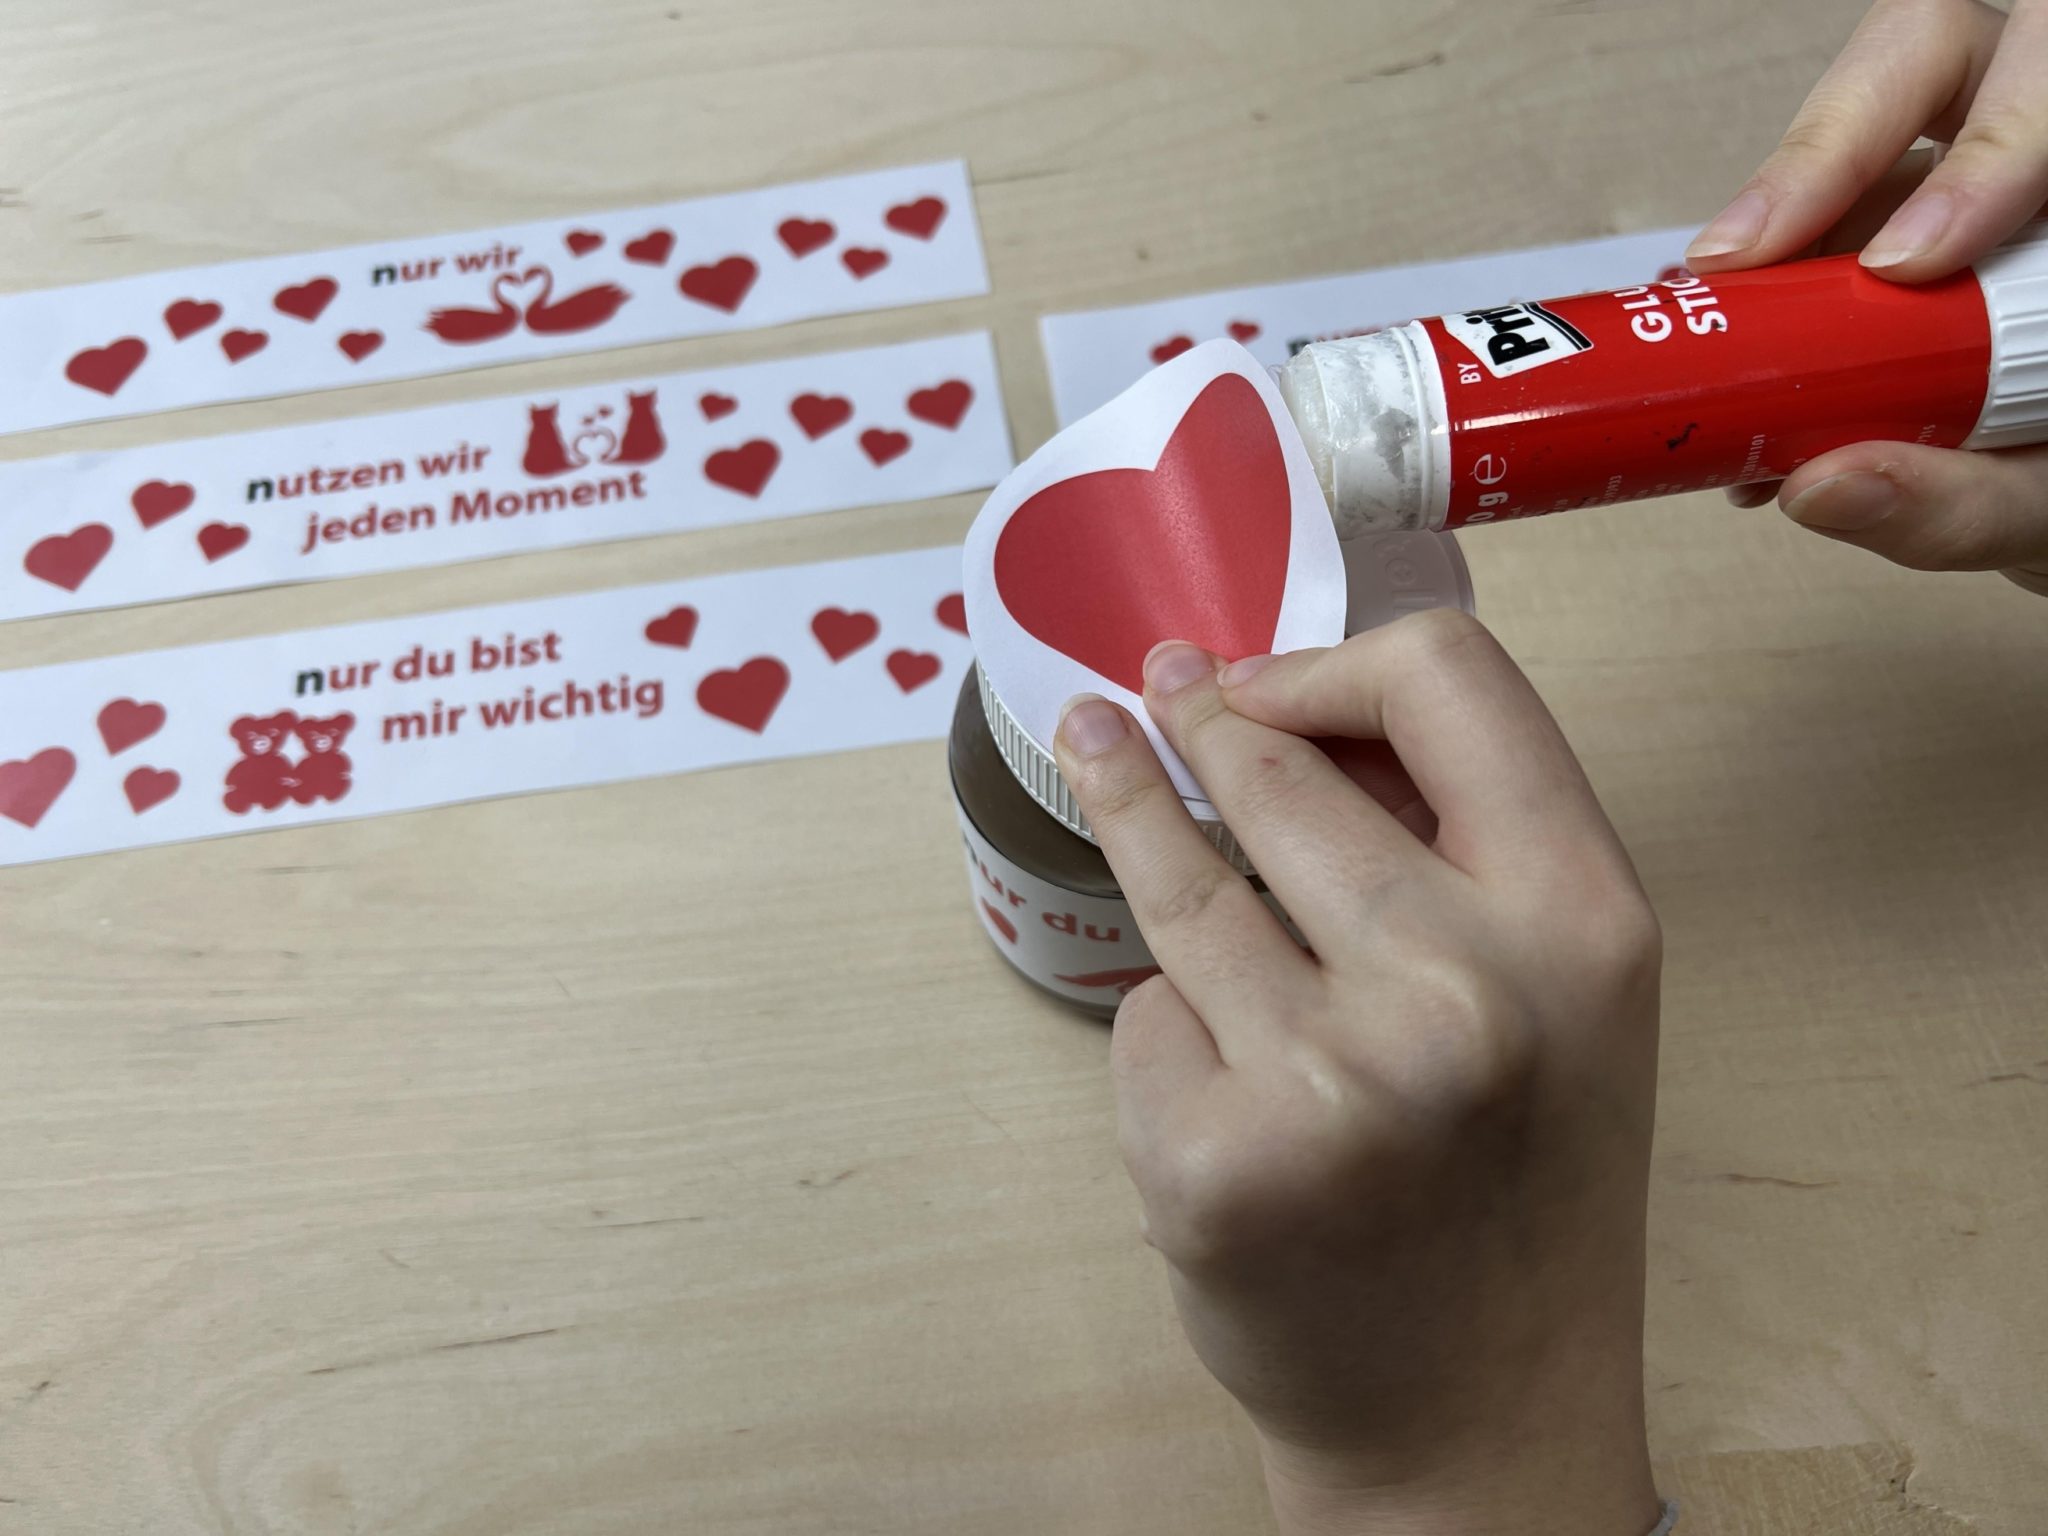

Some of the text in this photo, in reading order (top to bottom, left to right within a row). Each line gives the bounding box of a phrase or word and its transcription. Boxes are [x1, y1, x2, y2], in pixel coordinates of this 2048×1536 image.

[371, 243, 523, 287] nur wir
[1457, 362, 1482, 385] BY
[246, 444, 490, 504] nutzen wir
[1478, 491, 1509, 508] g
[300, 472, 646, 555] jeden Moment
[295, 631, 562, 697] nur du bist
[381, 675, 665, 742] mir wichtig
[1041, 911, 1121, 942] du
